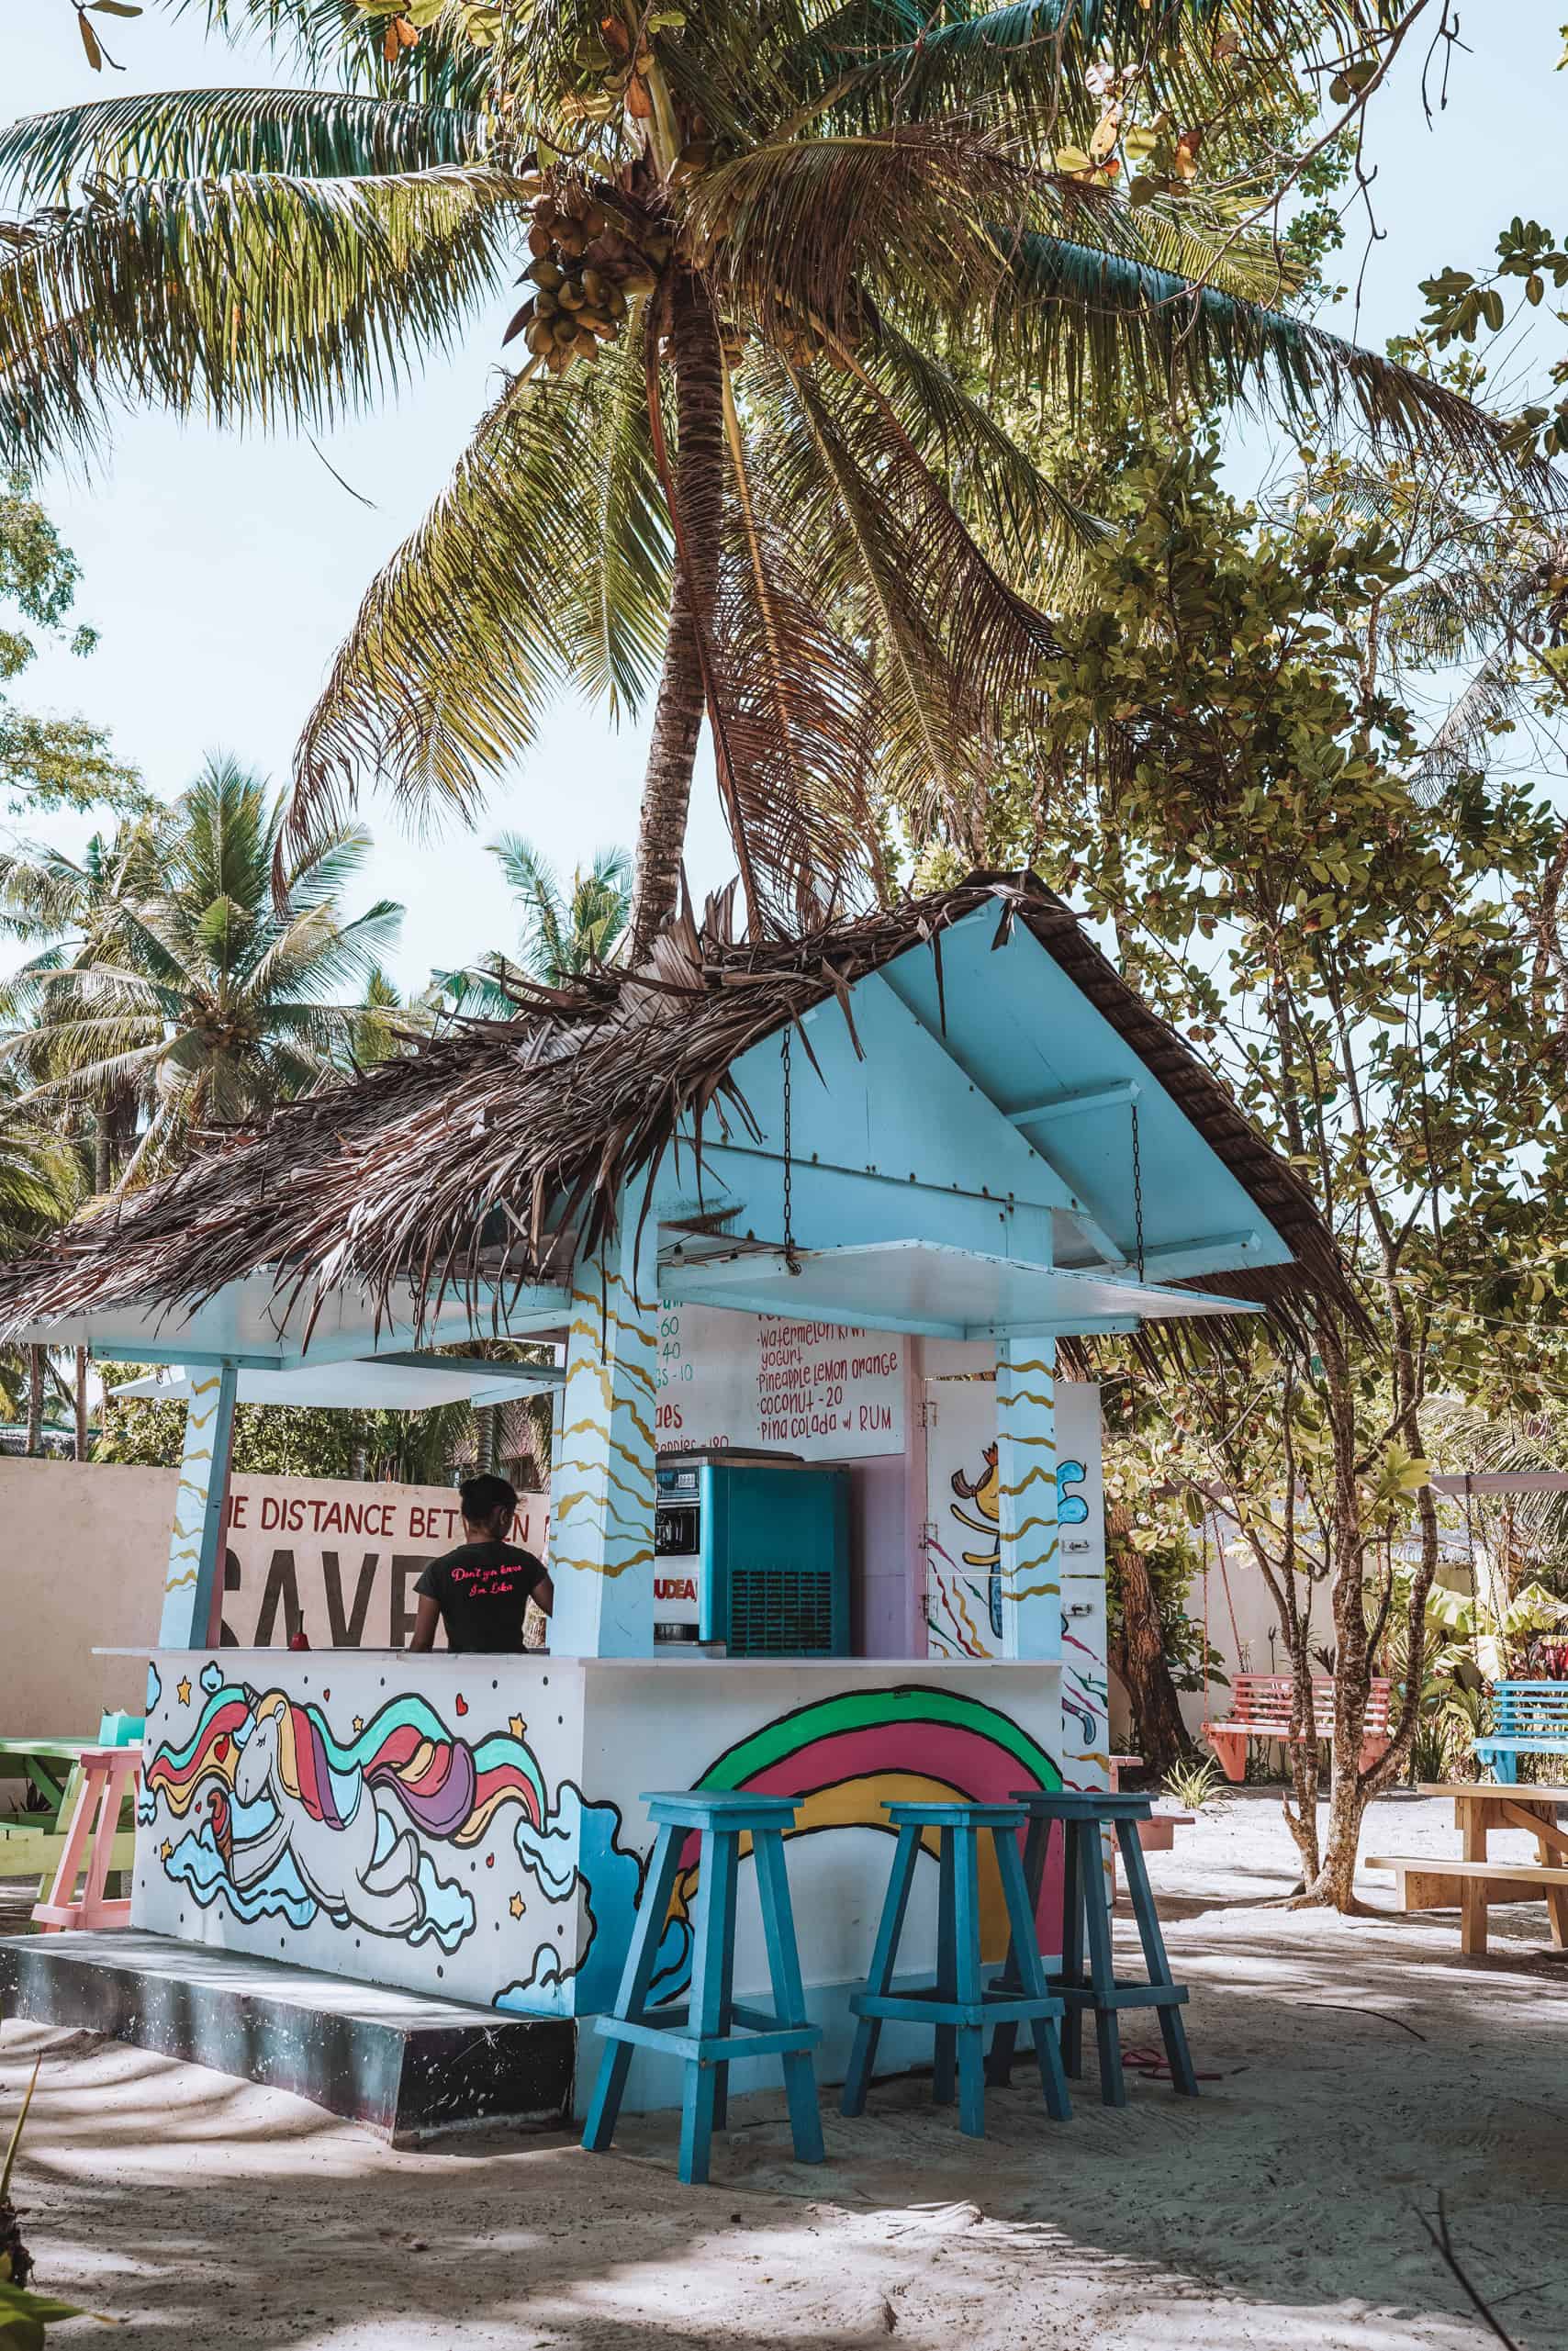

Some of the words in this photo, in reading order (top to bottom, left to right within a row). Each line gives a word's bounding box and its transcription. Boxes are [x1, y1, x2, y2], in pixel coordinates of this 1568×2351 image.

[859, 1405, 891, 1431] RUM
[262, 1497, 397, 1537] DISTANCE
[409, 1506, 530, 1543] BETN
